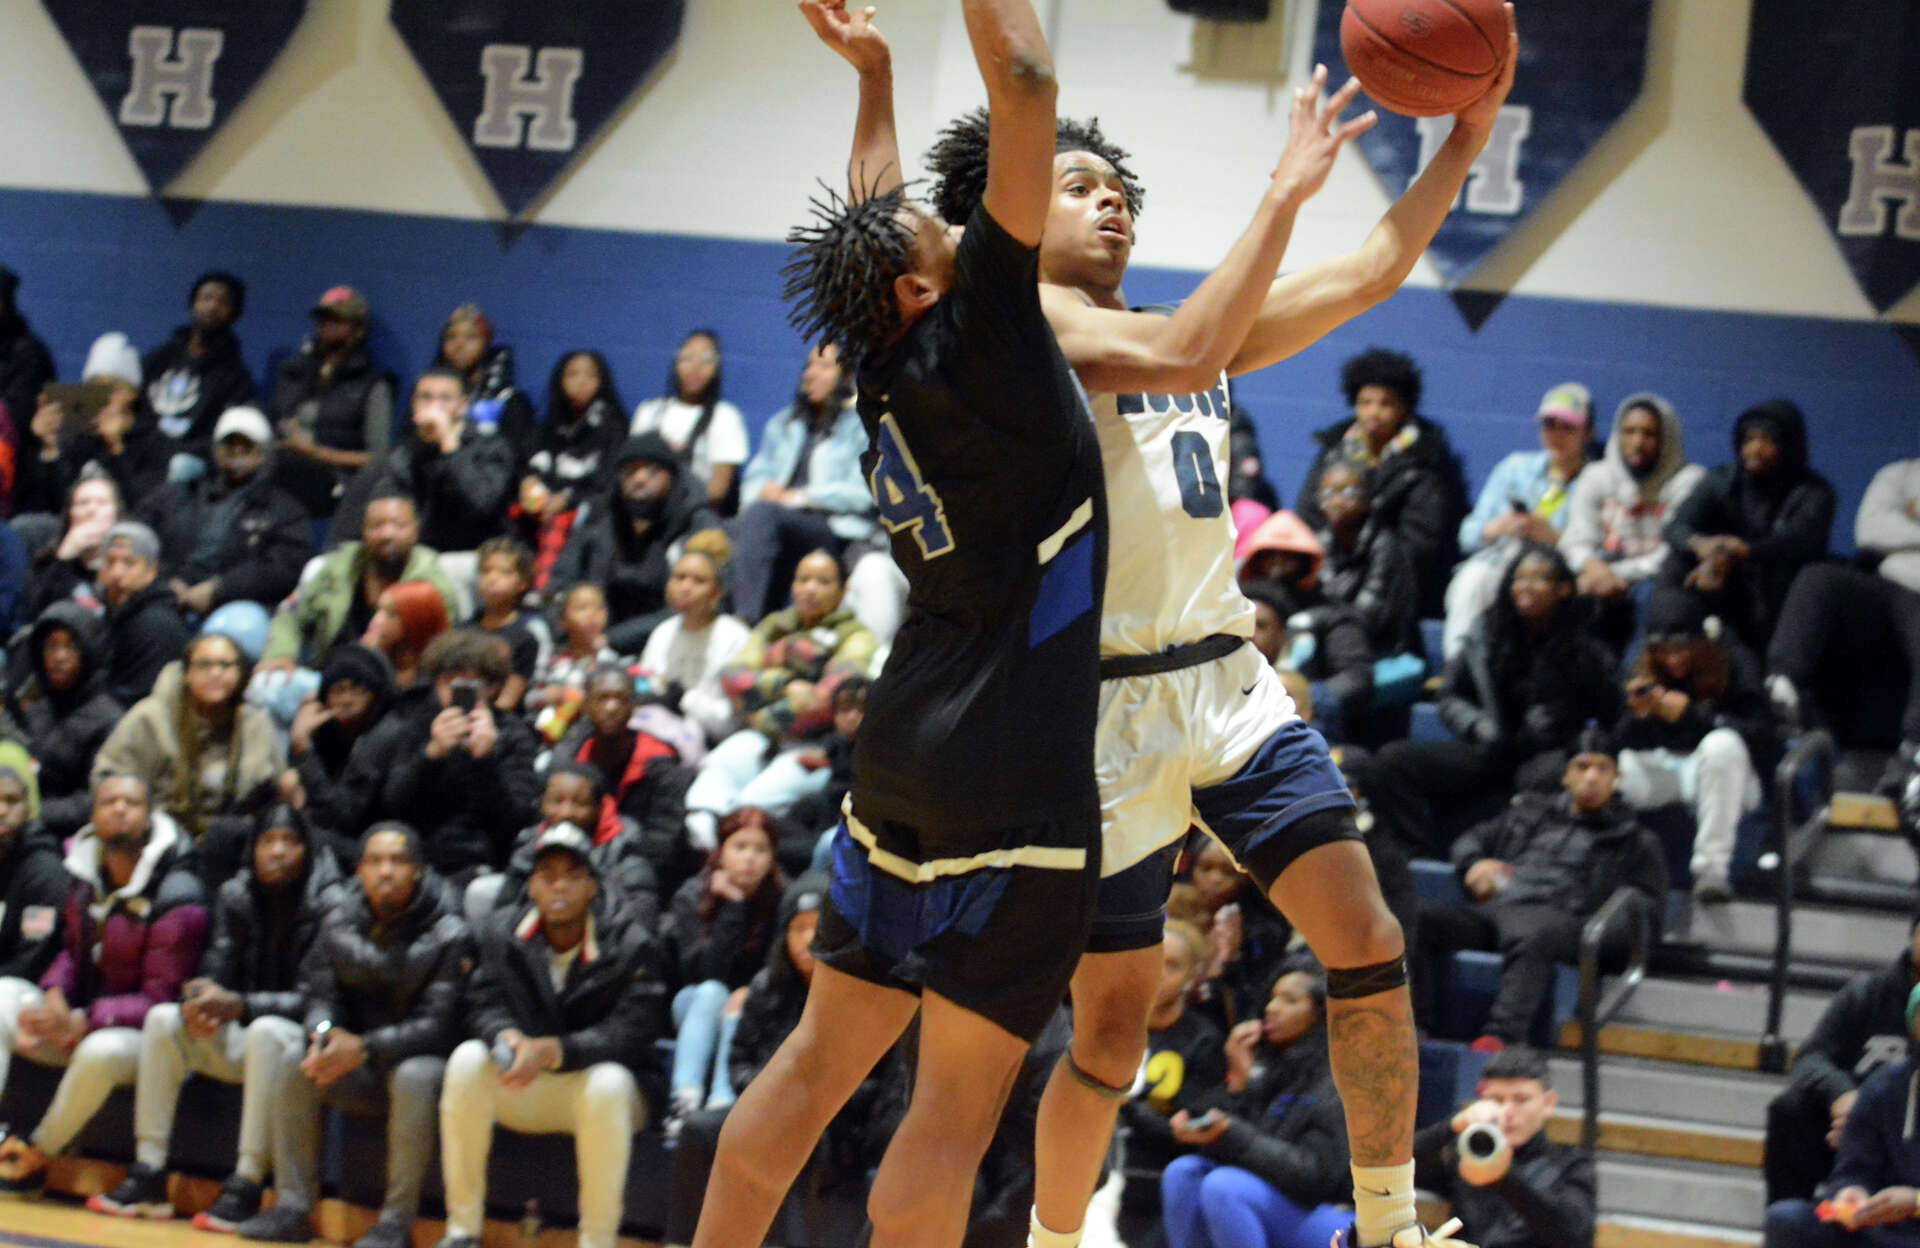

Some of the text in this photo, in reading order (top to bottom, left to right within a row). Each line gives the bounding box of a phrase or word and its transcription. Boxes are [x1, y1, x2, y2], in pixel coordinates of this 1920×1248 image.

[120, 26, 224, 129] H
[473, 44, 583, 151] H
[1838, 125, 1920, 239] H
[871, 411, 955, 561] 4
[1170, 430, 1224, 519] 0
